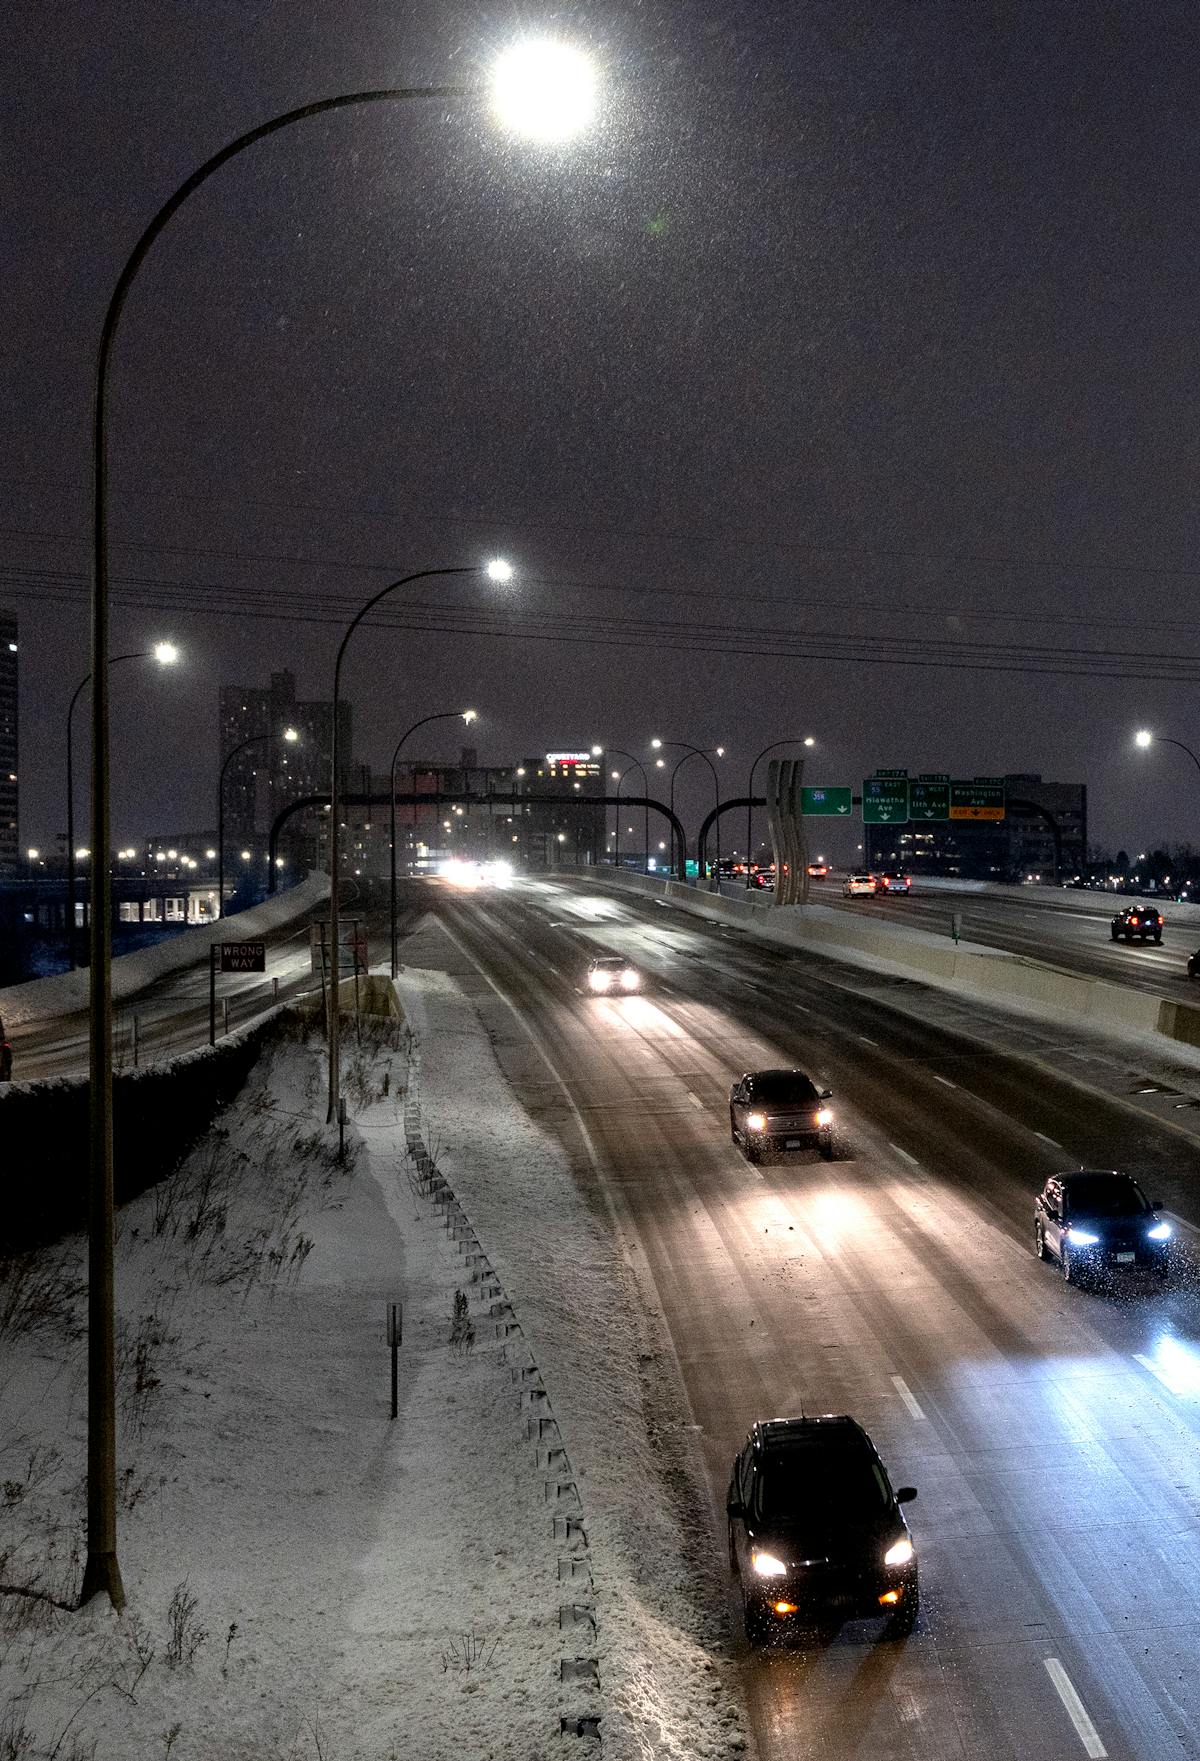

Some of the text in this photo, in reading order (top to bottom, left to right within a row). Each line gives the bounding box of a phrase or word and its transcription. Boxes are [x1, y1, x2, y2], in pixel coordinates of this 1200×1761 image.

[954, 788, 1001, 798] Washington
[865, 796, 905, 804] Hiawatha
[931, 800, 947, 808] Ave
[223, 946, 264, 956] WRONG
[231, 958, 255, 968] WAY
